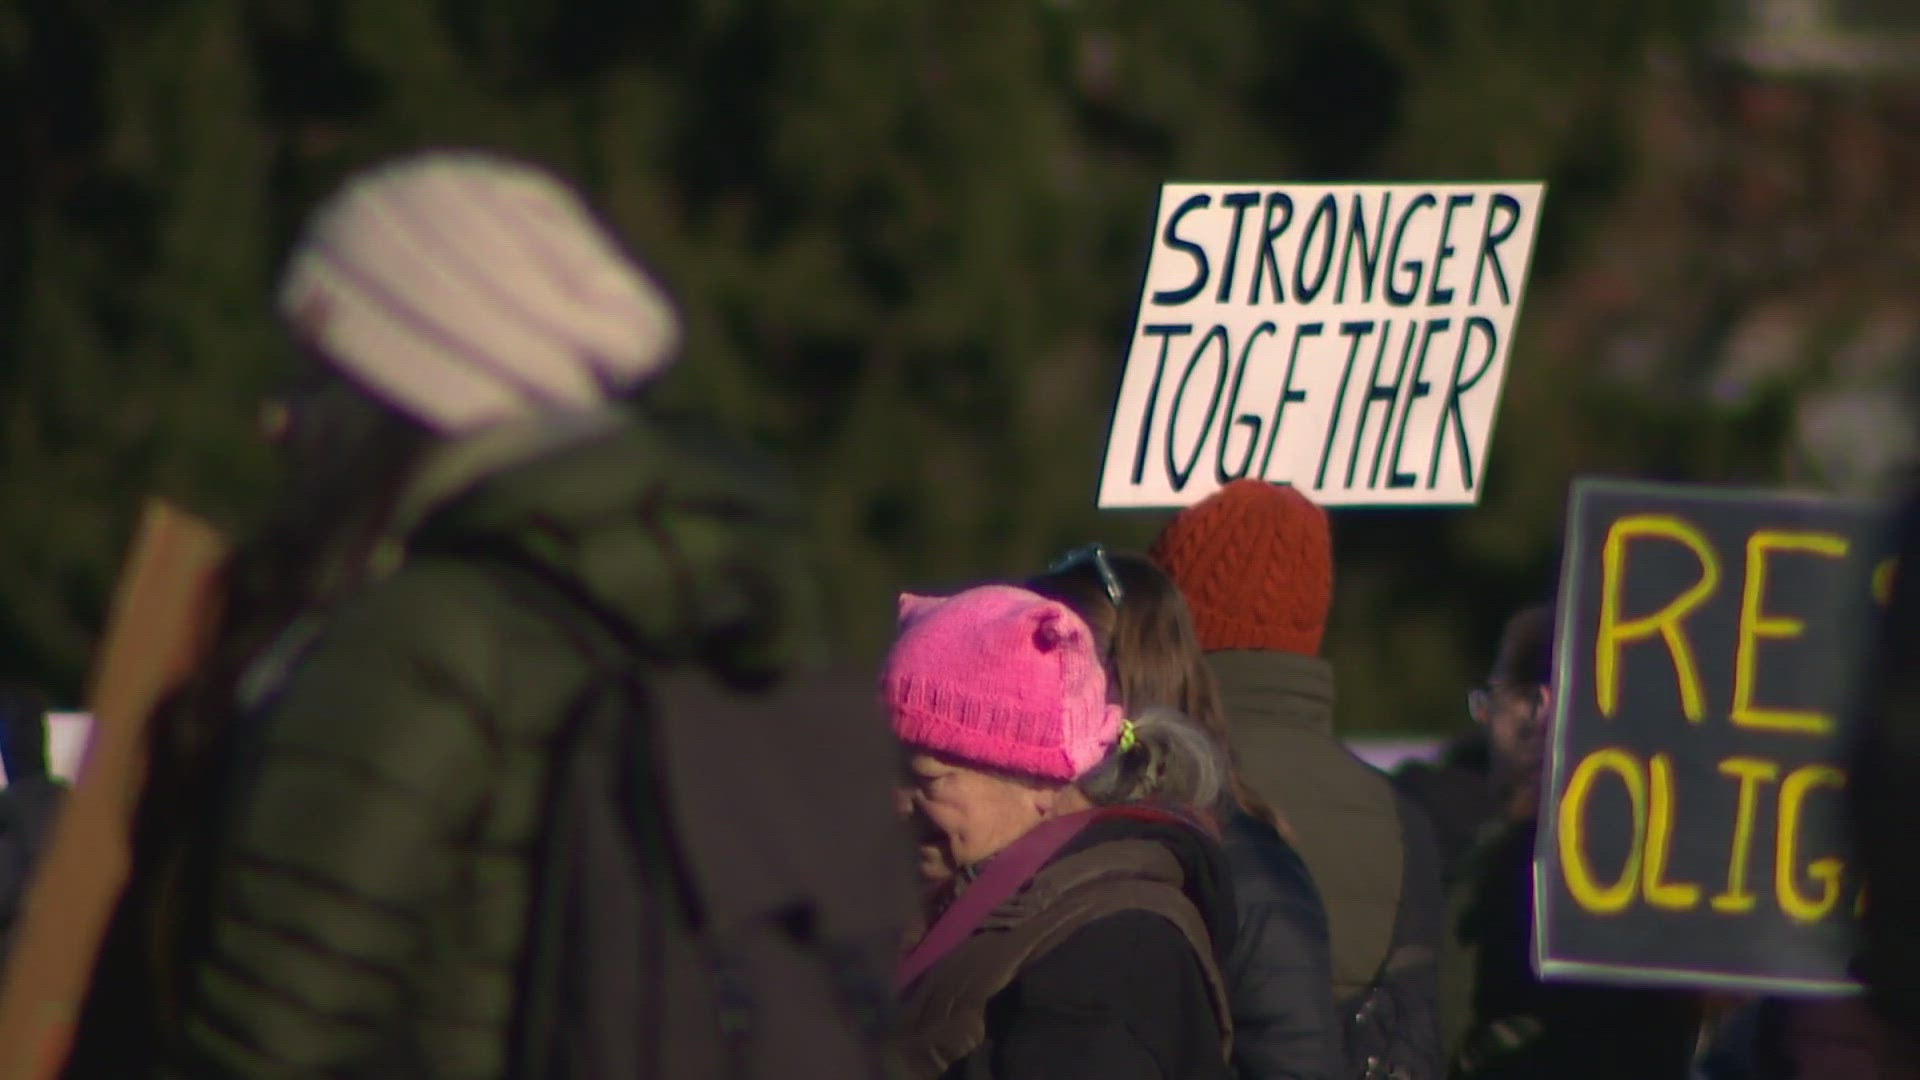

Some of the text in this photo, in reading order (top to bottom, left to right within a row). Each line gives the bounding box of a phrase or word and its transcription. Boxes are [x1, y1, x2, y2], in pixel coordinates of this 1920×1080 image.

[1151, 192, 1521, 306] STRONGER
[1131, 317, 1497, 491] TOGETHER
[1596, 514, 1897, 735] RE
[1557, 748, 1869, 923] OLIG
